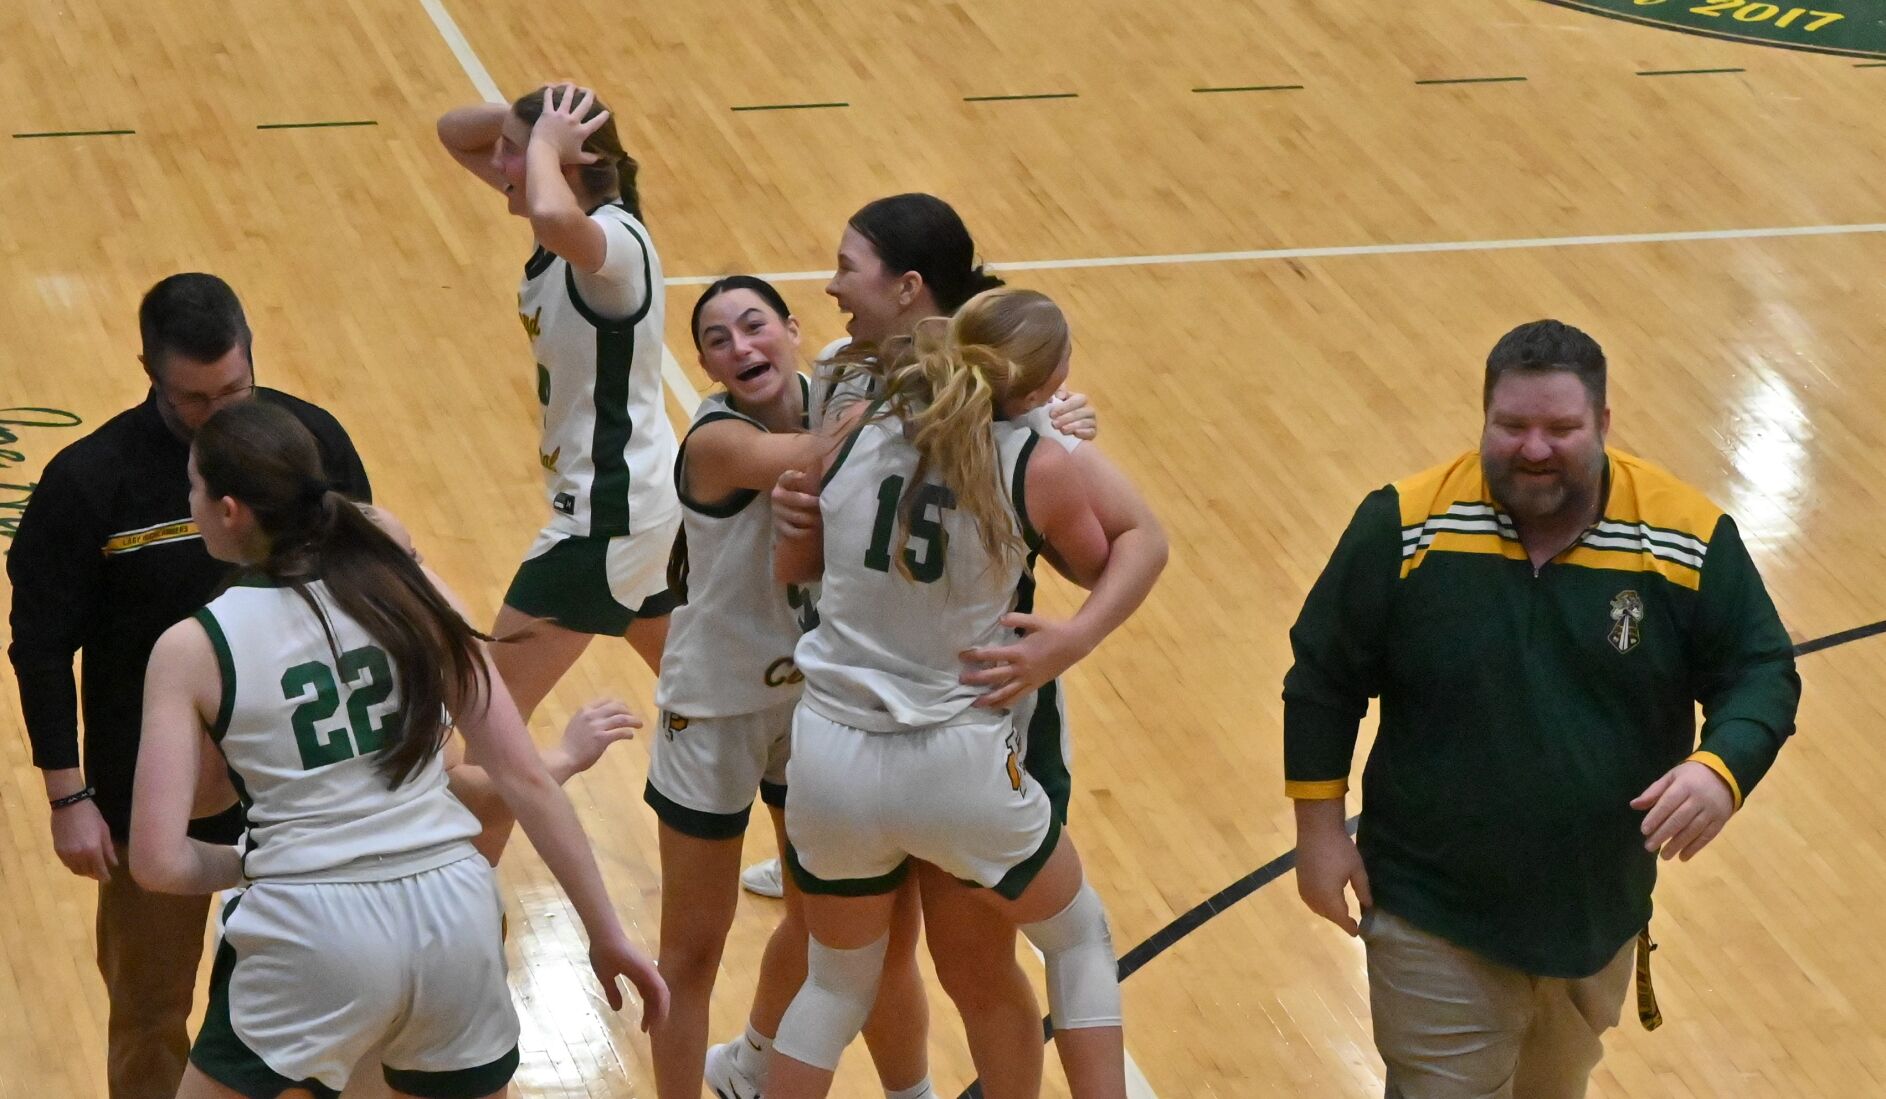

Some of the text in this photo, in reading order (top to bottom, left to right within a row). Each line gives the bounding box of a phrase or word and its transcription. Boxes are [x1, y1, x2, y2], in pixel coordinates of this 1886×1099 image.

[1689, 0, 1845, 31] 2017
[864, 474, 958, 583] 15
[281, 645, 403, 771] 22
